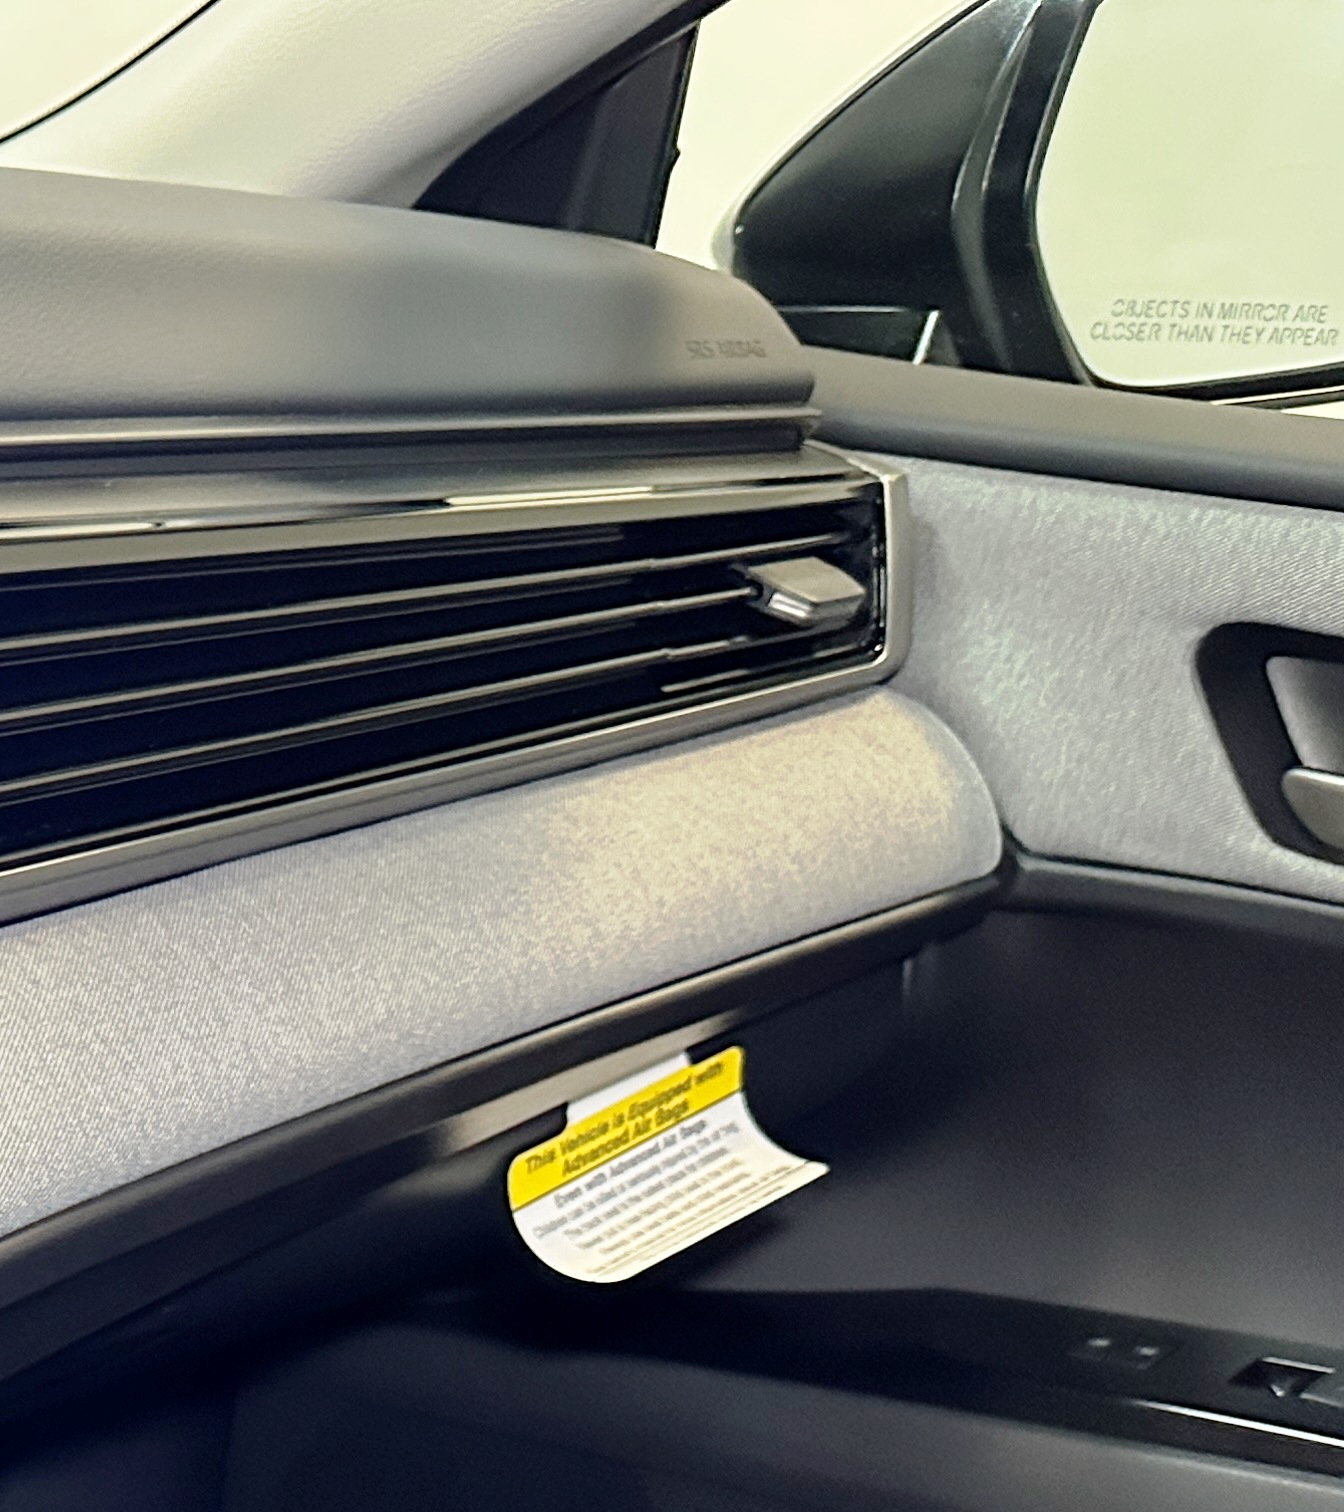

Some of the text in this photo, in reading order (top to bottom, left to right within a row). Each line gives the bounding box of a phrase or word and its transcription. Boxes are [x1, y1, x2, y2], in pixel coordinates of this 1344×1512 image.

[1111, 299, 1329, 323] OBJECTS IN MIRROR ARE
[1090, 321, 1338, 346] CLOSER THAN THEY APPEAR
[525, 1147, 557, 1175] This
